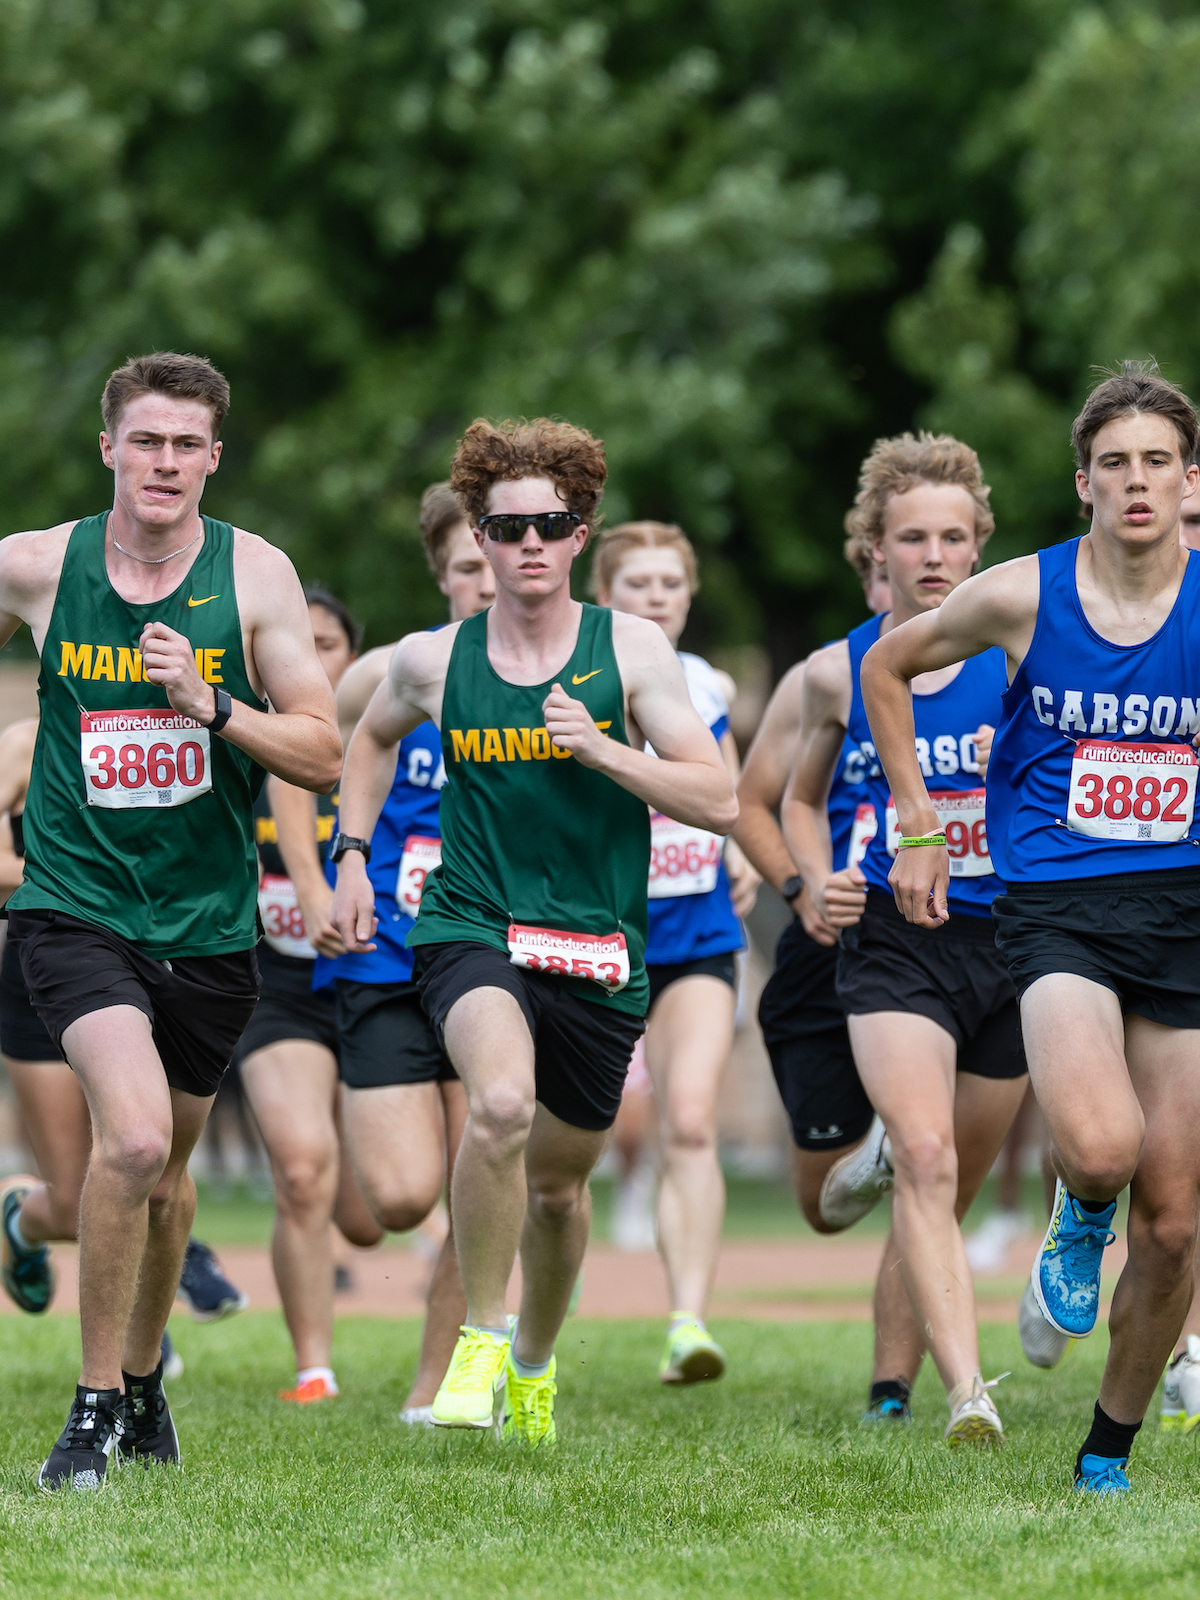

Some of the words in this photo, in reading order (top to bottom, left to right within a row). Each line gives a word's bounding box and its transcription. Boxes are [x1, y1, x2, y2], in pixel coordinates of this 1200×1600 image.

[57, 641, 226, 684] MANE
[449, 720, 613, 764] MANO
[1082, 746, 1192, 765] runforeducation
[89, 741, 205, 790] 3860
[1074, 773, 1188, 822] 3882
[515, 931, 620, 954] runforeducation
